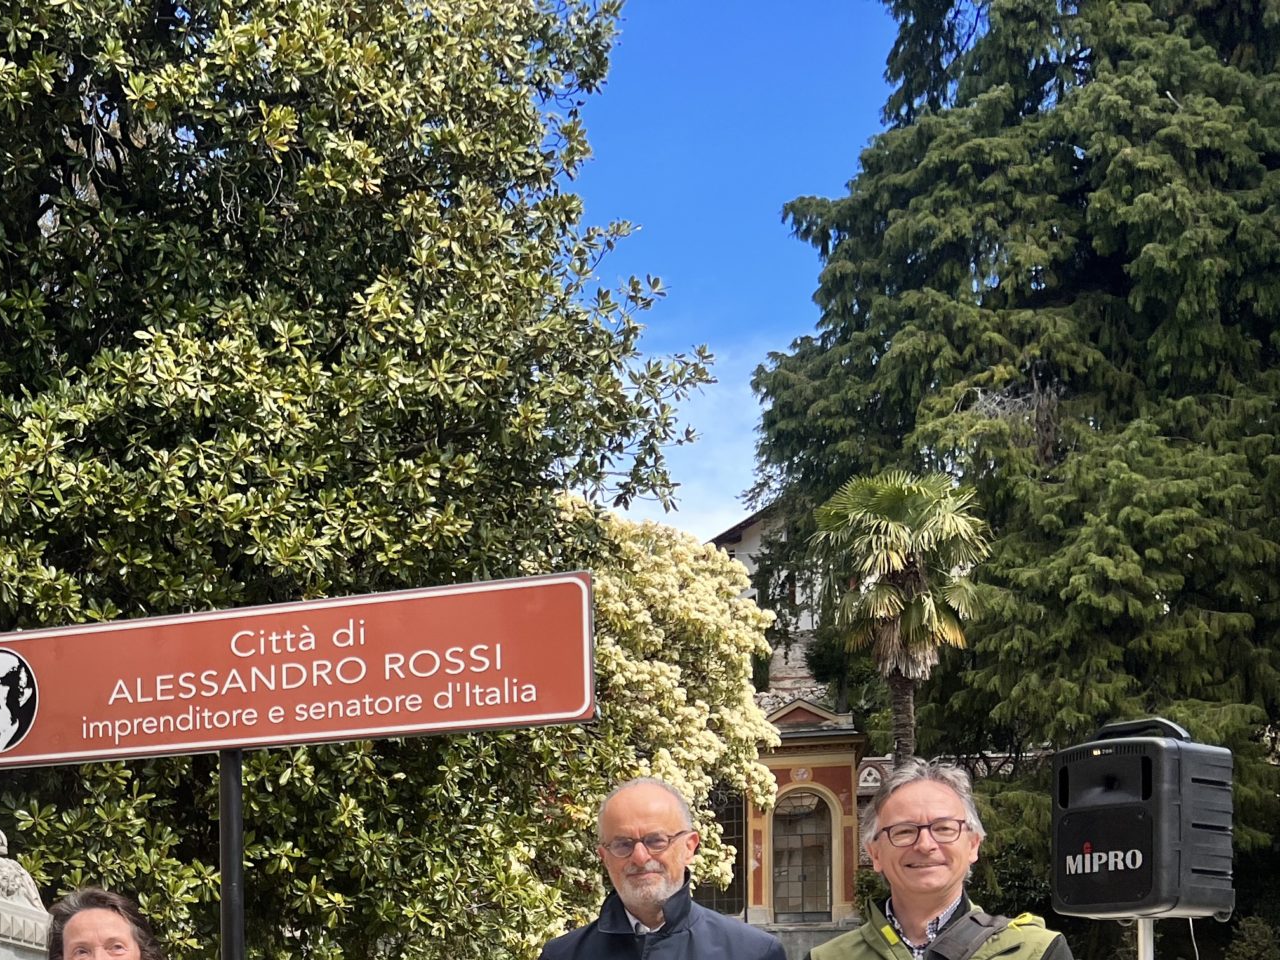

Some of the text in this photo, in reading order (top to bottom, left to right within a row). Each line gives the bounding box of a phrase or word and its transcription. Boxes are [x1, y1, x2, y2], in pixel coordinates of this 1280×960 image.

[229, 618, 365, 658] Città di
[107, 643, 502, 706] ALESSANDRO ROSSI
[82, 676, 537, 746] imprenditore e senatore d'Italia
